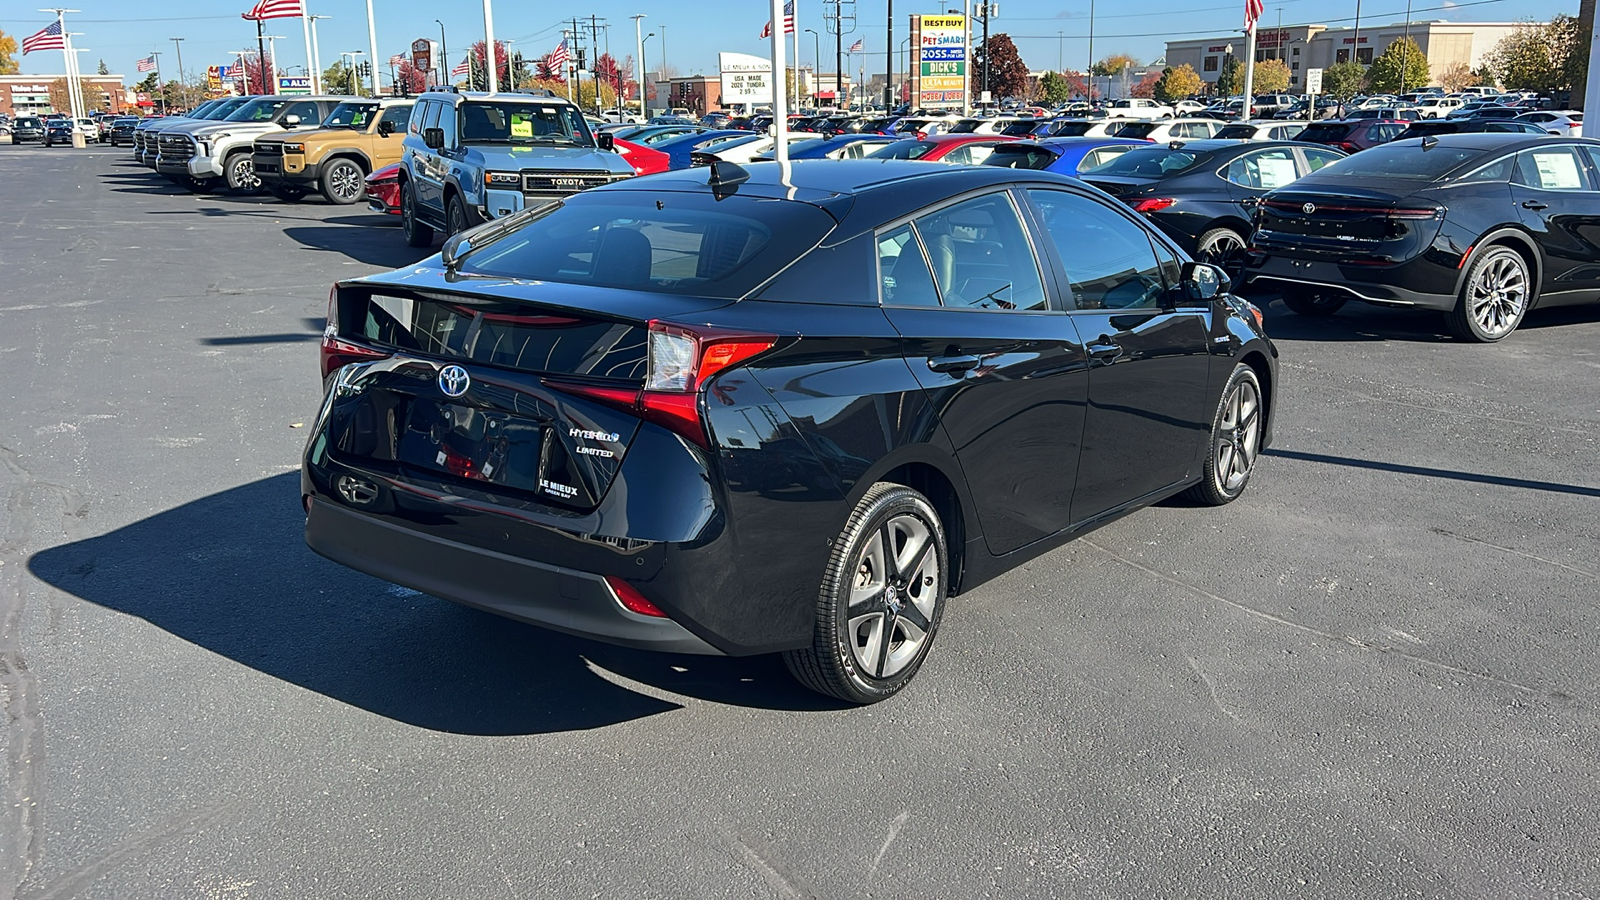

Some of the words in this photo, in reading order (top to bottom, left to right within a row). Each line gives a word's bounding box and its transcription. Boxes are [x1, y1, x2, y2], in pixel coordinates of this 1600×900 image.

[922, 50, 947, 59] ROSS
[930, 62, 958, 73] DICK'S
[924, 78, 942, 87] ULTA
[921, 92, 943, 101] HOBBY
[944, 91, 964, 100] LOBBY
[576, 446, 614, 457] LIMITED
[540, 478, 549, 488] LE
[550, 481, 578, 497] MIEUX
[545, 488, 560, 496] GREEN
